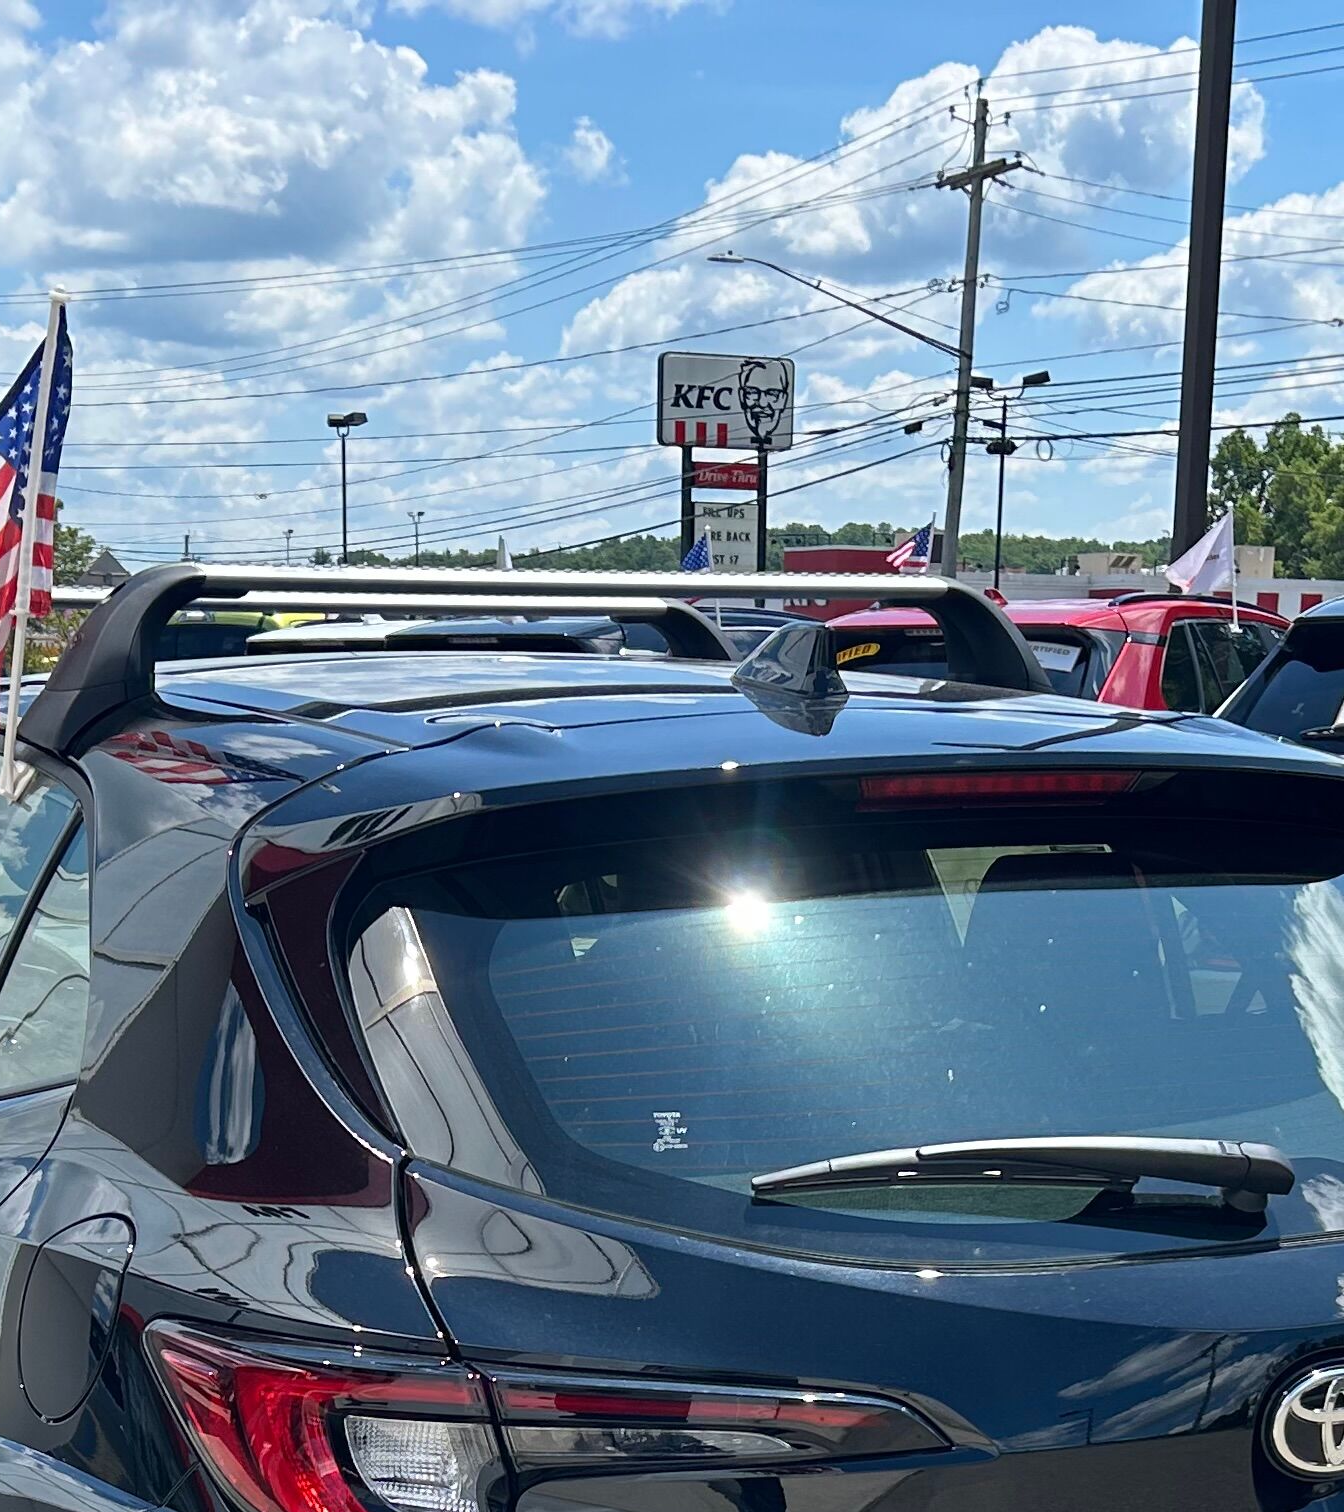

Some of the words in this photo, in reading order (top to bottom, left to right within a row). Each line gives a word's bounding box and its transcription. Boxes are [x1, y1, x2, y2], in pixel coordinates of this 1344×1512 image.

[670, 383, 732, 410] KFC
[727, 508, 745, 519] UPS
[726, 532, 751, 542] BACK
